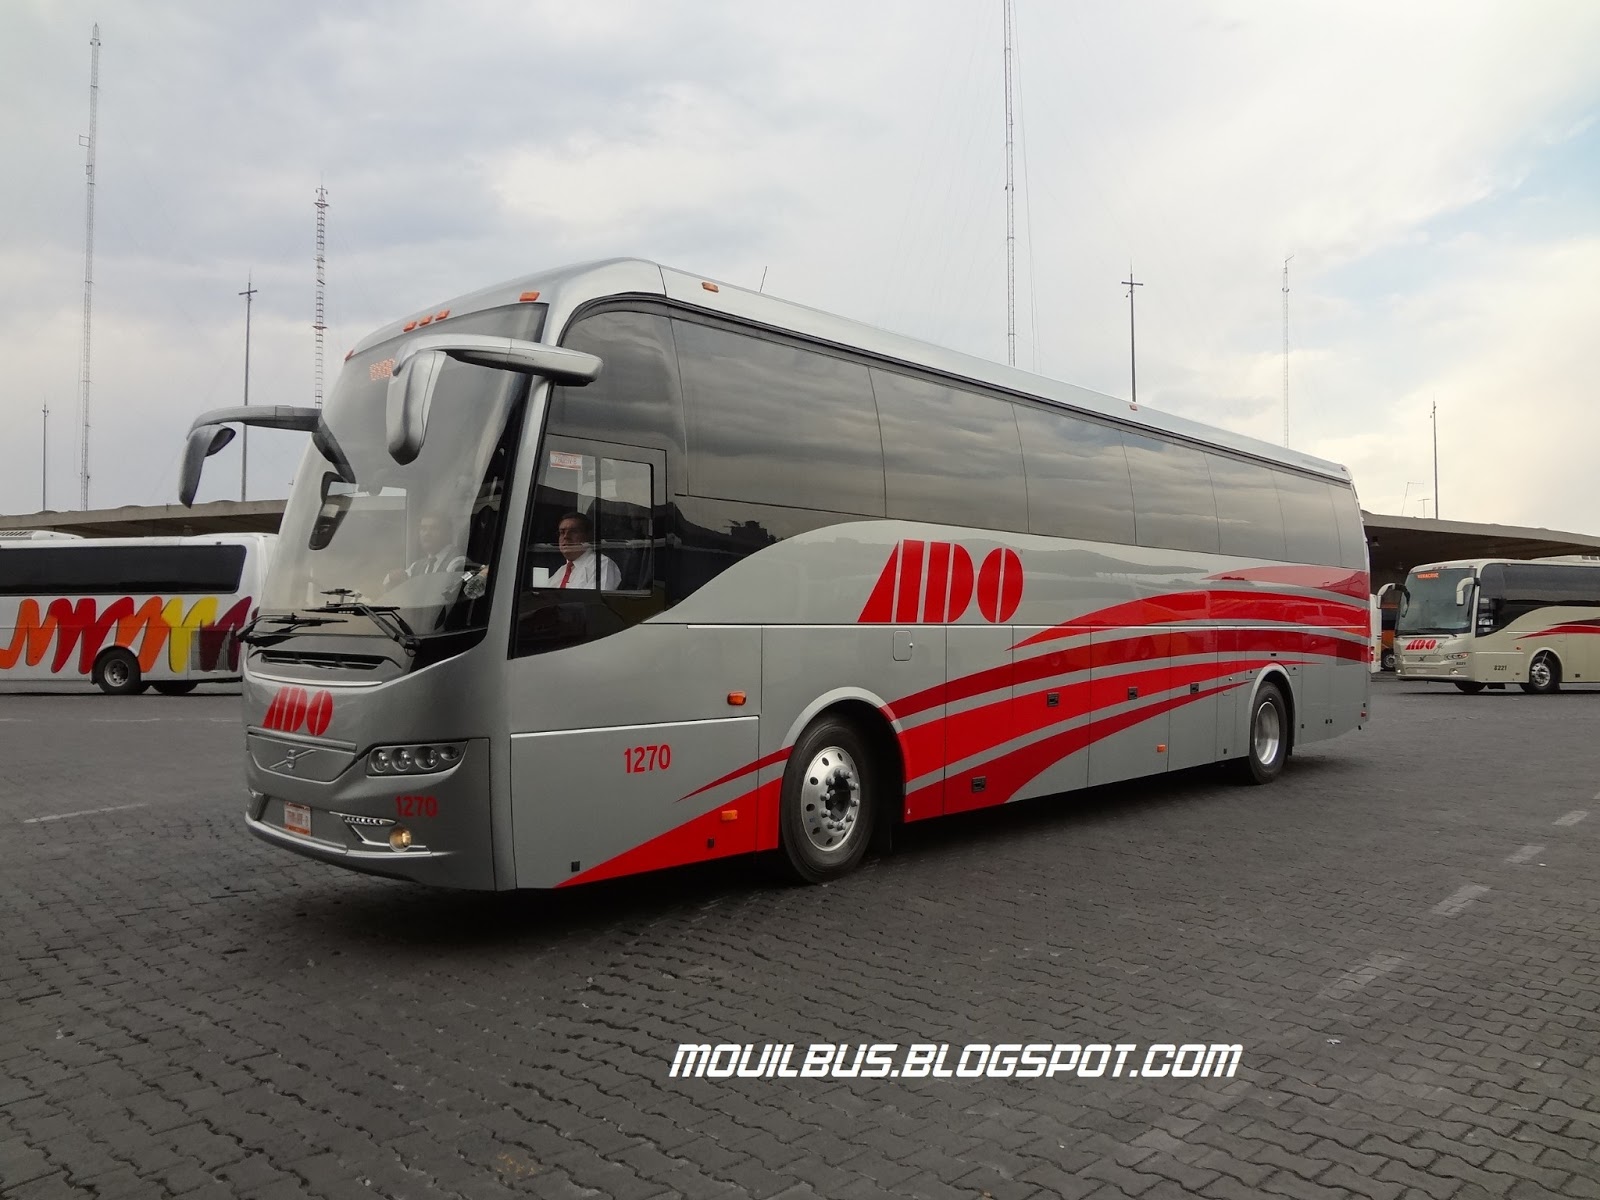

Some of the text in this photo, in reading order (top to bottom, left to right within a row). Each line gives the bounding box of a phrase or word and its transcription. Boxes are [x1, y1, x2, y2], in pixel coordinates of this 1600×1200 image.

[858, 539, 1024, 624] ADO
[1405, 639, 1436, 650] ADO
[262, 685, 334, 736] ADO
[624, 744, 671, 774] 1270
[395, 795, 438, 817] 1270
